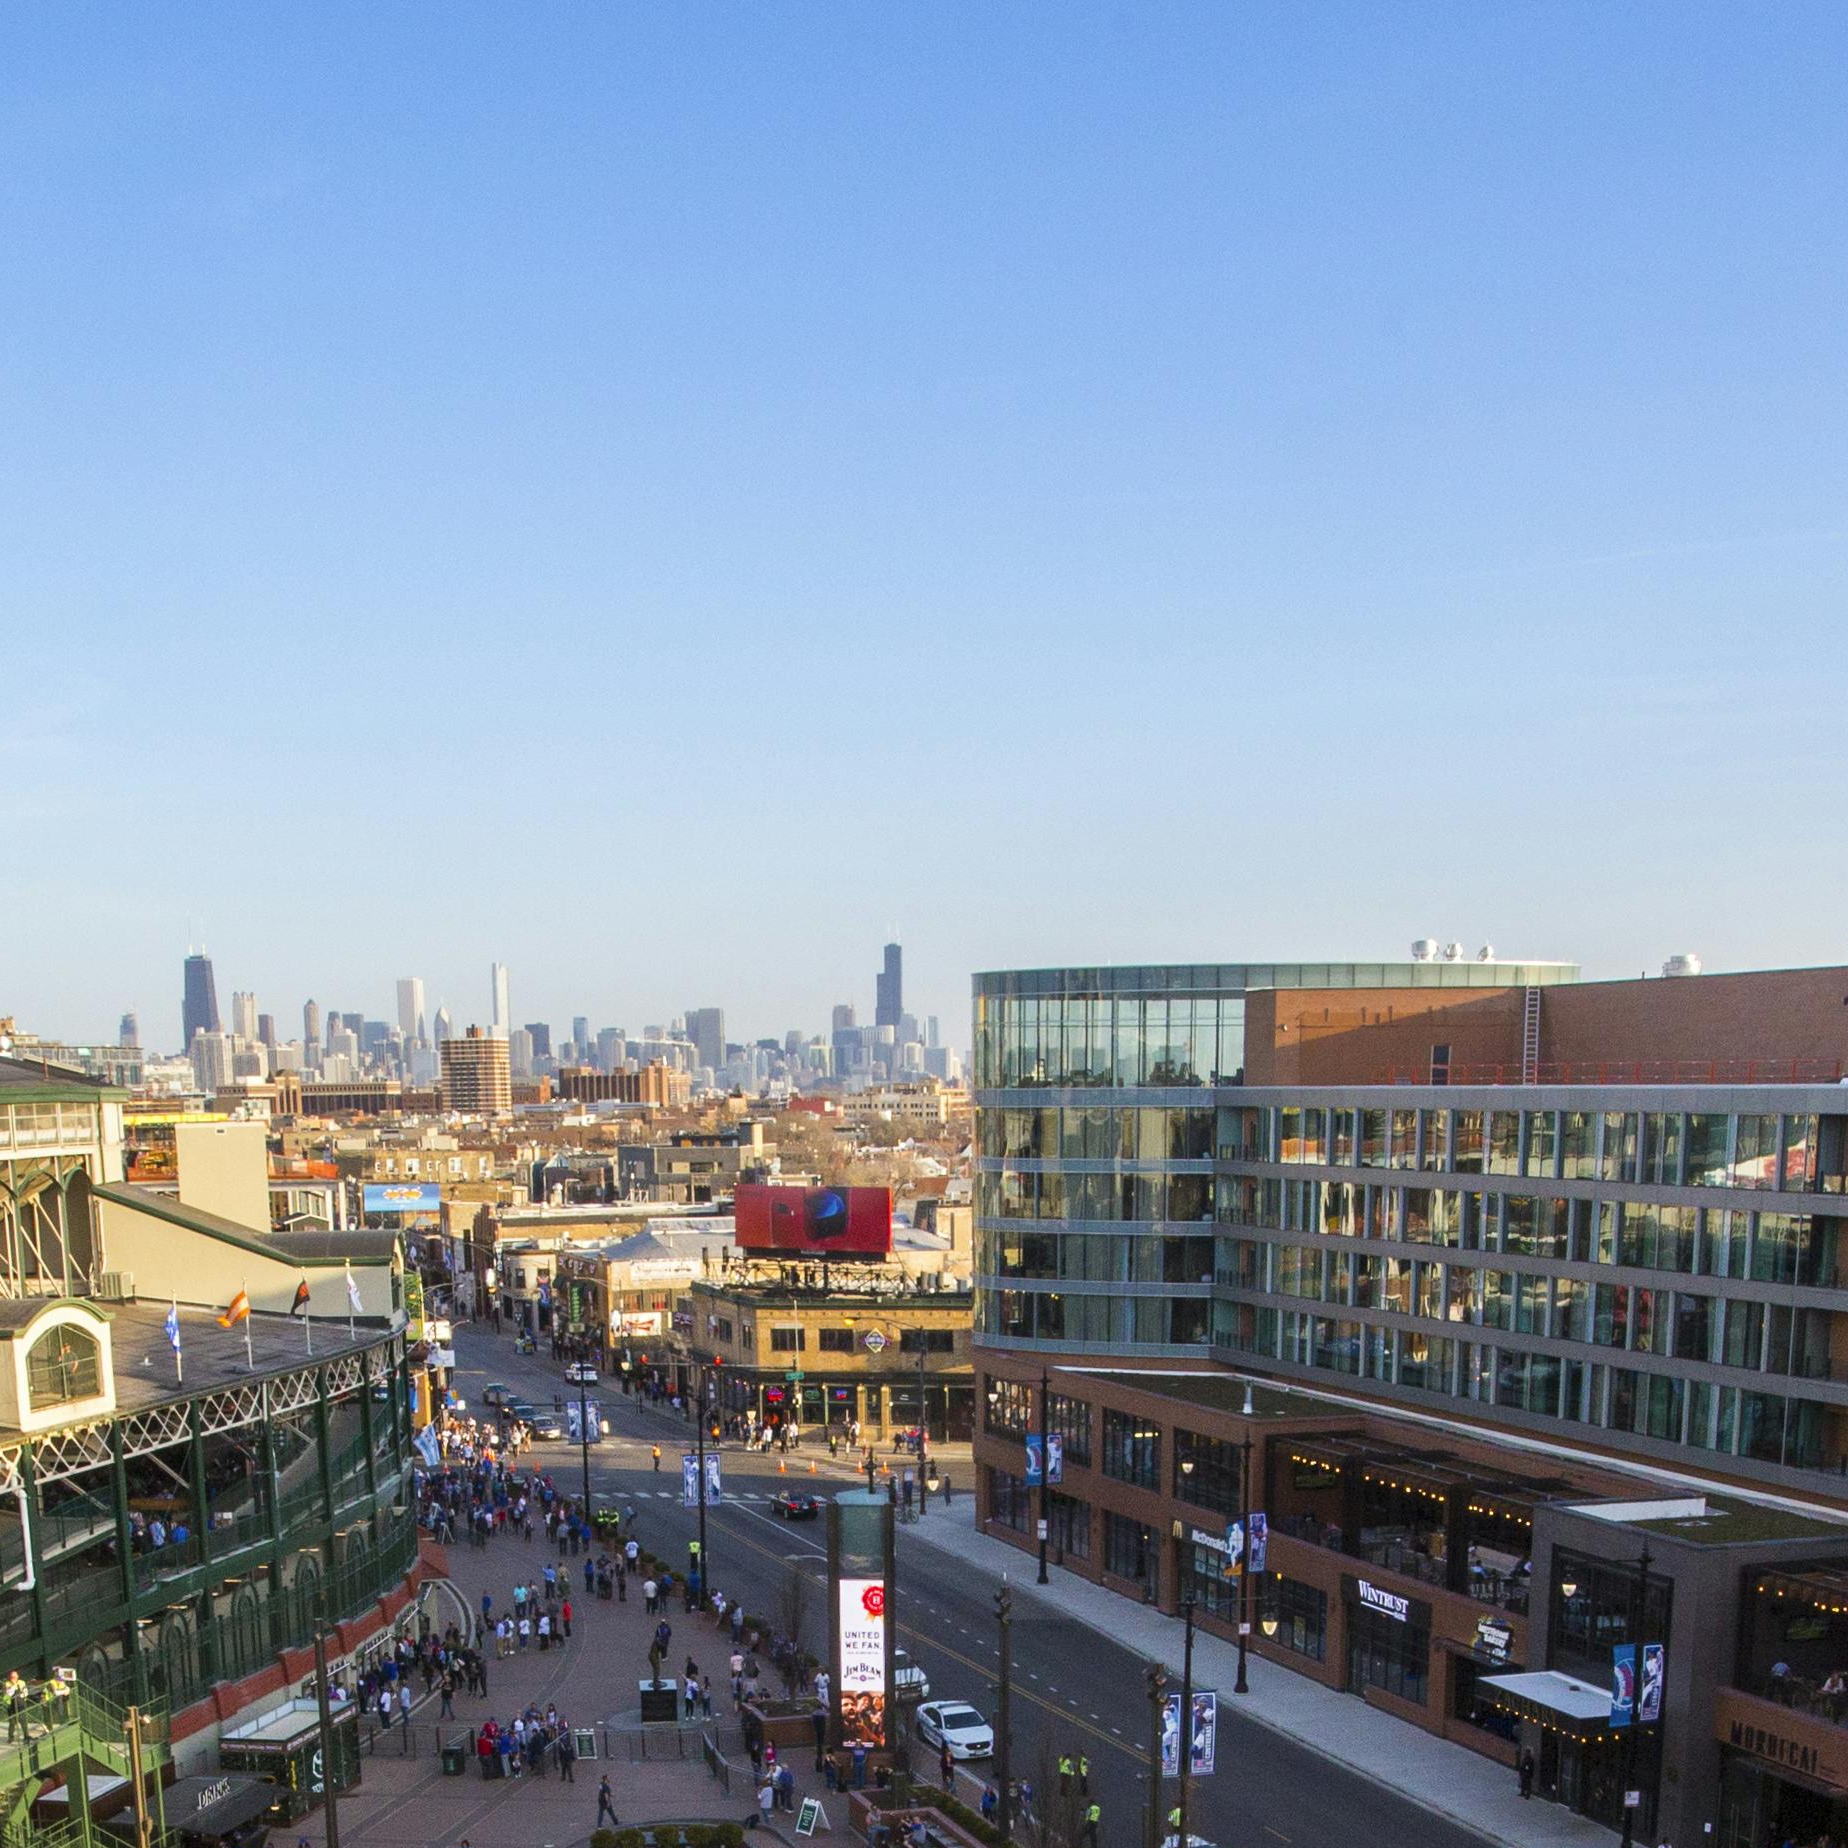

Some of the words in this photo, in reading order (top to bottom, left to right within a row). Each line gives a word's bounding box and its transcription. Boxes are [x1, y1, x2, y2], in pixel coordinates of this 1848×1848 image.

[1358, 1579, 1409, 1613] WINTRUST
[845, 1631, 880, 1639] UNITED
[844, 1666, 858, 1678] JIM
[859, 1662, 881, 1679] BEAM
[1731, 1720, 1818, 1776] MORDECAI
